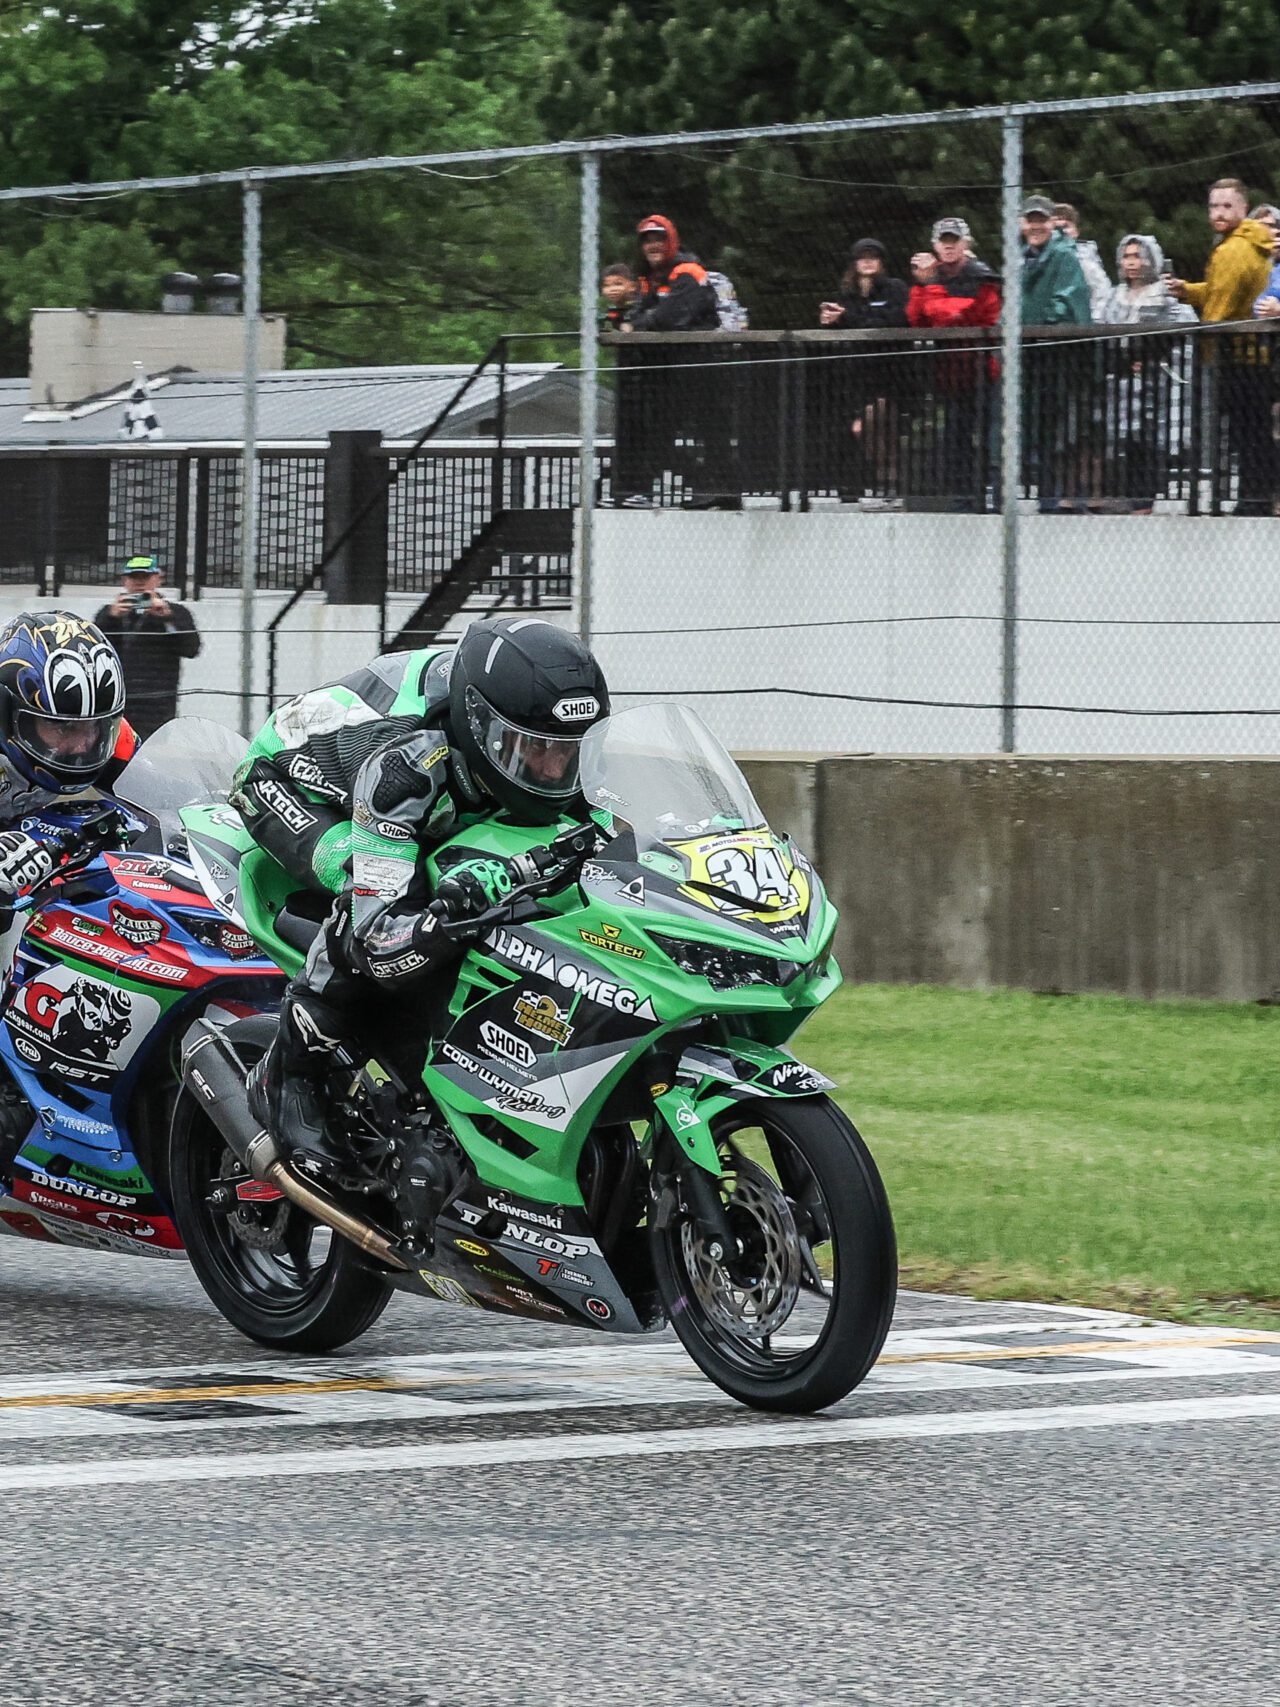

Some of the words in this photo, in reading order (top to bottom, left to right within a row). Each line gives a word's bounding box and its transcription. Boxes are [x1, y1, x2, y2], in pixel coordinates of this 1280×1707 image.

[562, 702, 595, 718] SHOEI
[132, 879, 172, 892] Kawasaki
[705, 847, 800, 915] 34
[580, 930, 645, 958] CORTECH
[517, 1000, 574, 1034] HELMET
[518, 1012, 568, 1045] HOUSE
[18, 1040, 39, 1059] Arai
[485, 1023, 531, 1063] SHOEI
[48, 1061, 111, 1082] RST
[441, 1042, 478, 1074] CODY
[477, 1066, 546, 1108] WYMAN
[476, 1043, 506, 1066] PREMIUM
[504, 1059, 538, 1082] HELMETS
[191, 1068, 216, 1101] SC
[495, 1095, 566, 1119] Racing
[30, 1171, 137, 1208] DUNLOP
[487, 1196, 563, 1230] Kawasaki
[460, 1209, 590, 1260] DNLOP
